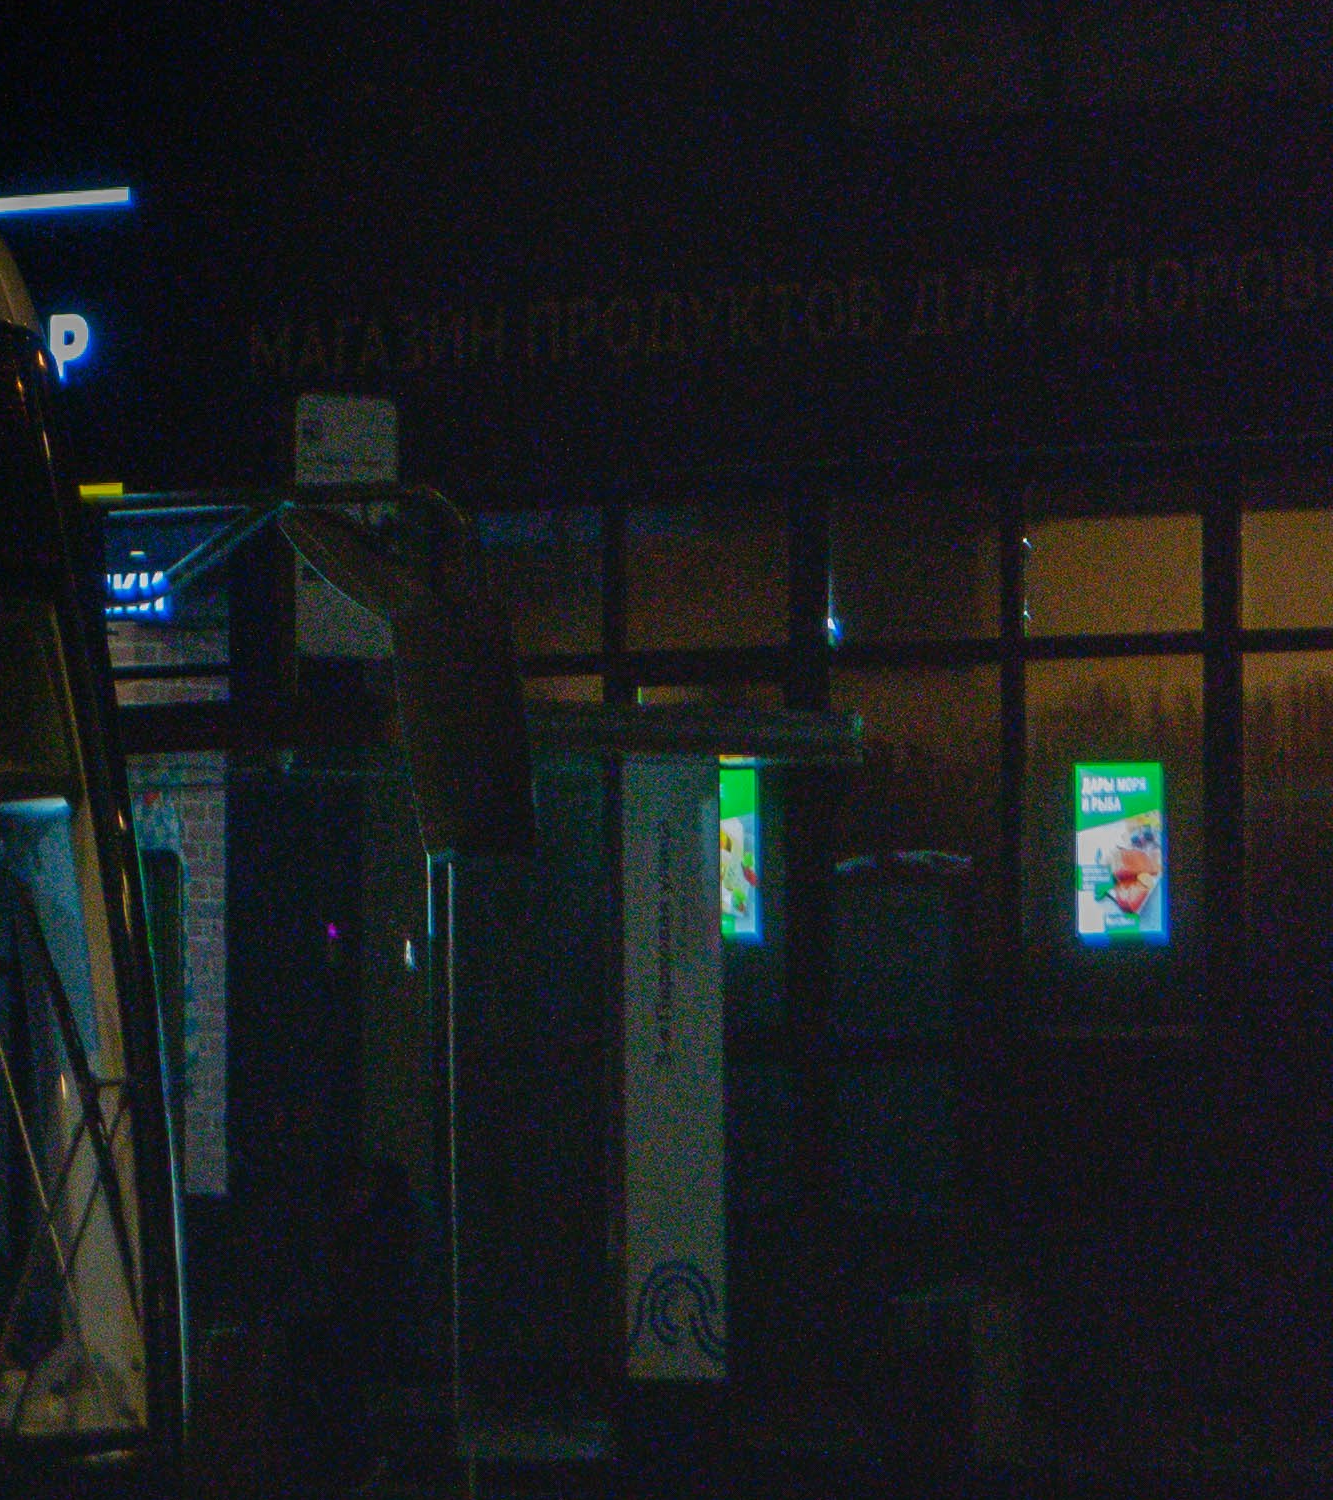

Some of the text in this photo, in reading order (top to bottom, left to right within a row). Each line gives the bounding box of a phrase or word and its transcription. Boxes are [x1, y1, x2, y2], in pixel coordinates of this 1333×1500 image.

[247, 303, 506, 376] МАГАЗИН
[524, 273, 885, 363] ПРОДУКТОВ
[909, 266, 1036, 341] ДЛЯ
